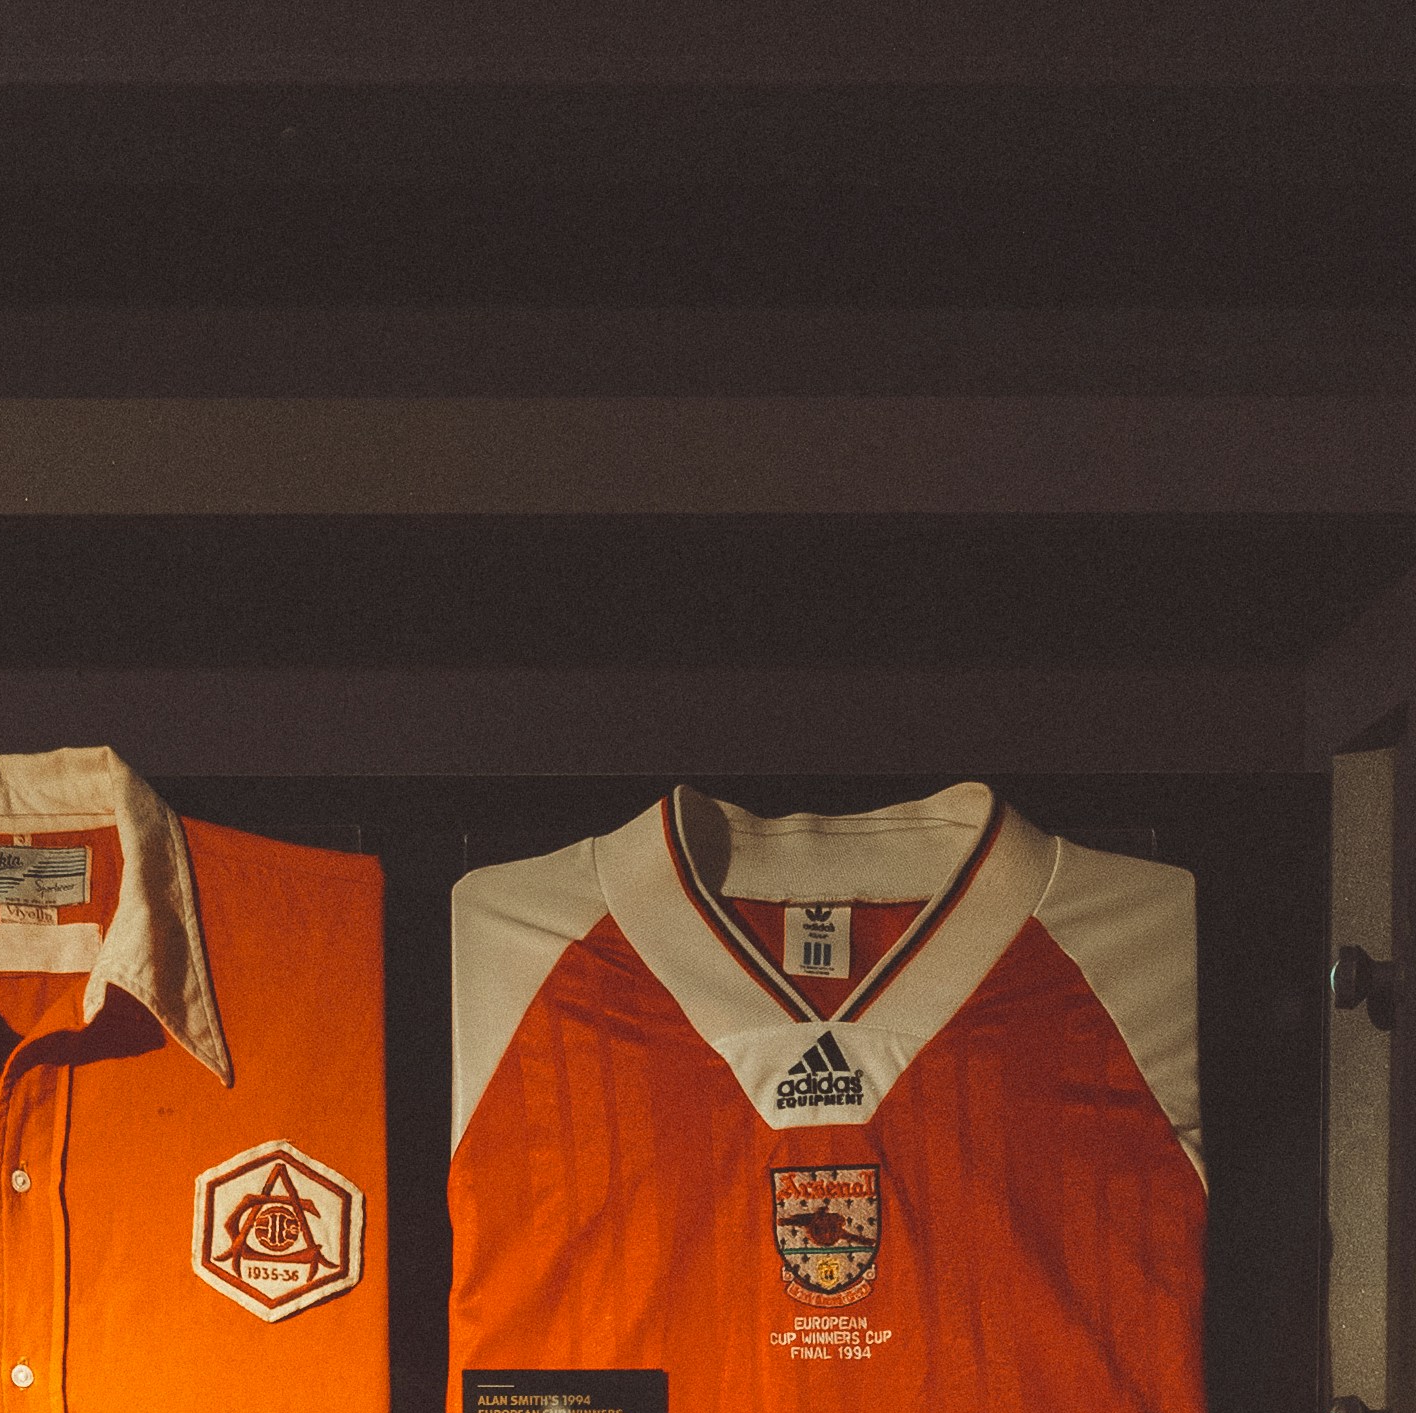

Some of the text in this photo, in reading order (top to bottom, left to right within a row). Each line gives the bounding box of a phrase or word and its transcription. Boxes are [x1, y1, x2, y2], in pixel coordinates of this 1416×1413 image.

[777, 1072, 863, 1097] adidas
[777, 1094, 864, 1109] EQUIPMENT
[776, 1170, 876, 1200] Arsenal
[248, 1267, 299, 1282] 1935-36
[794, 1317, 867, 1330] EUROPEAN
[770, 1330, 892, 1345] CUP WINNERS CUP
[791, 1346, 871, 1359] FINAL 1994
[478, 1395, 591, 1405] ALAN SMITH'S 1994
